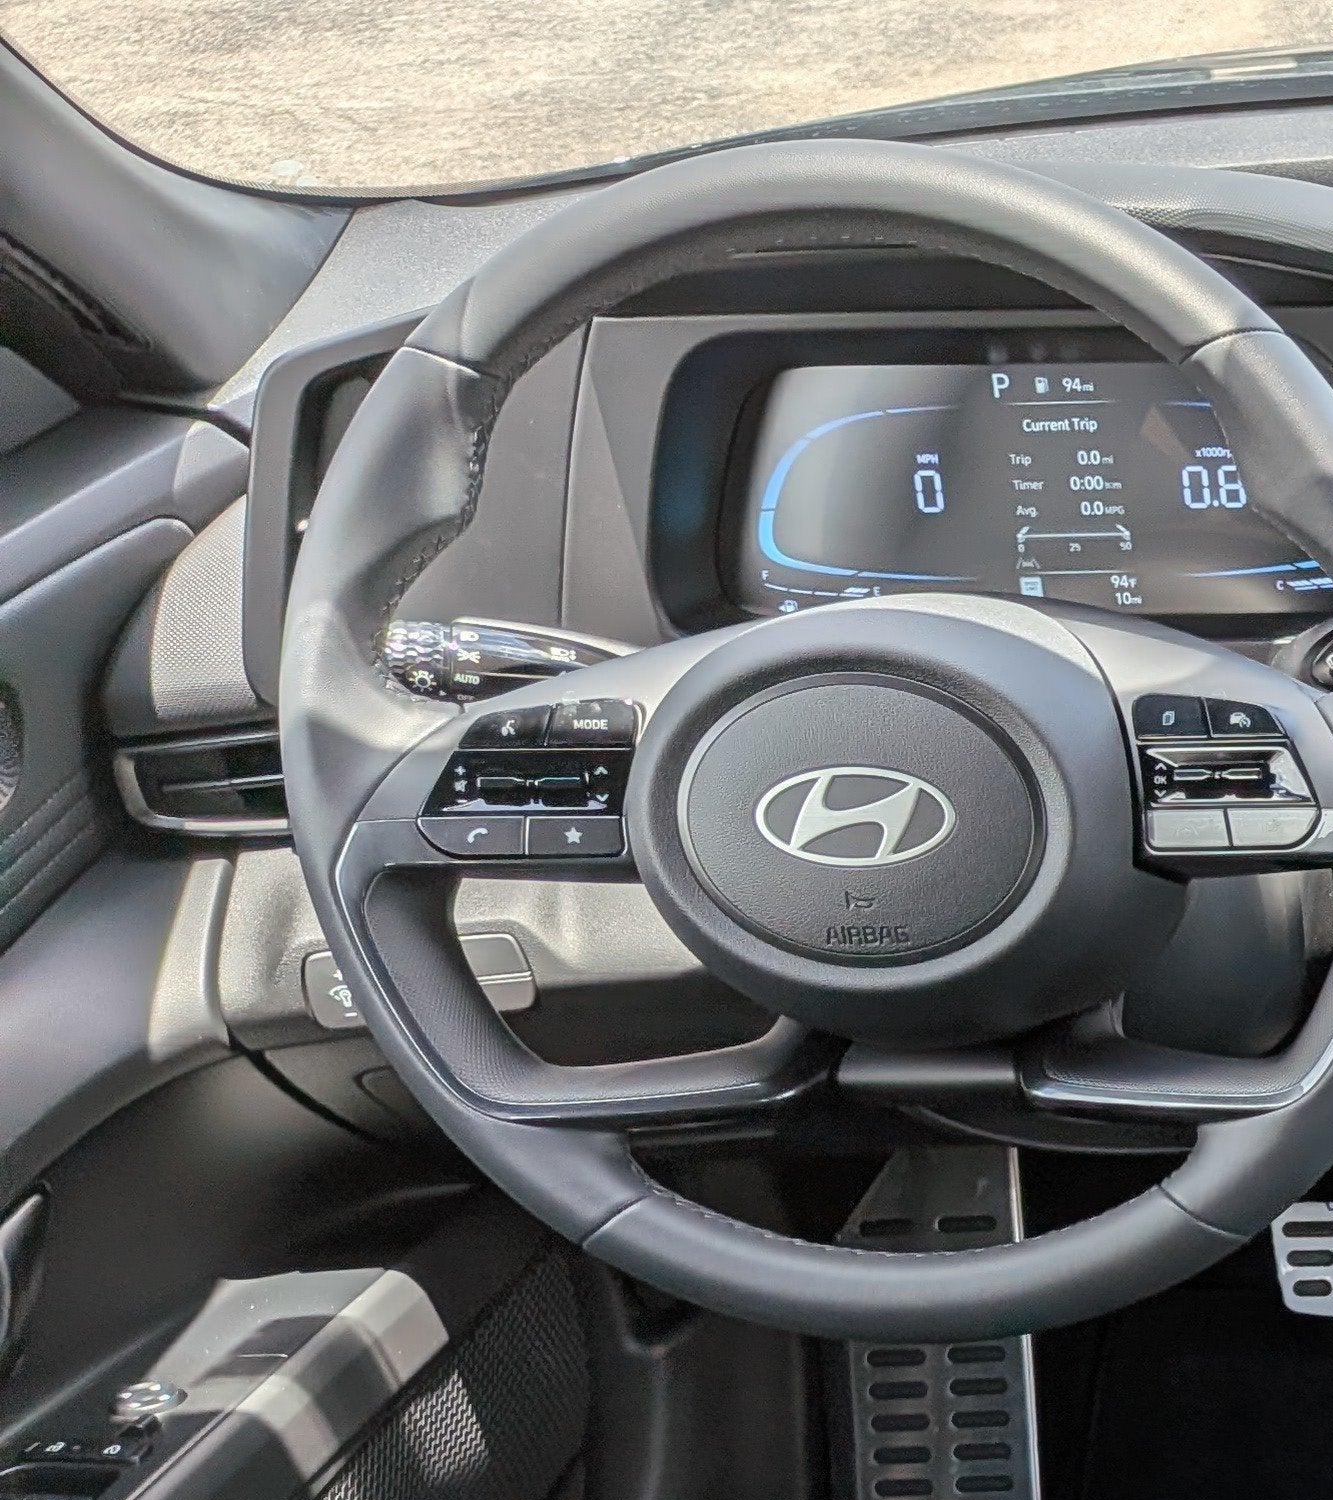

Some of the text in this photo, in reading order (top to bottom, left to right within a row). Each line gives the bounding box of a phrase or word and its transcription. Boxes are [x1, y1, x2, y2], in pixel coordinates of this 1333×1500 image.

[991, 373, 1009, 398] P
[1022, 417, 1098, 433] Current Trip
[916, 453, 938, 464] MPH
[1009, 453, 1032, 466] Trip
[1012, 480, 1044, 490] Timer
[914, 470, 944, 513] 0
[762, 570, 768, 580] F
[453, 673, 480, 685] AUTO
[573, 719, 608, 730] MODE
[826, 926, 909, 945] AIRBAG
